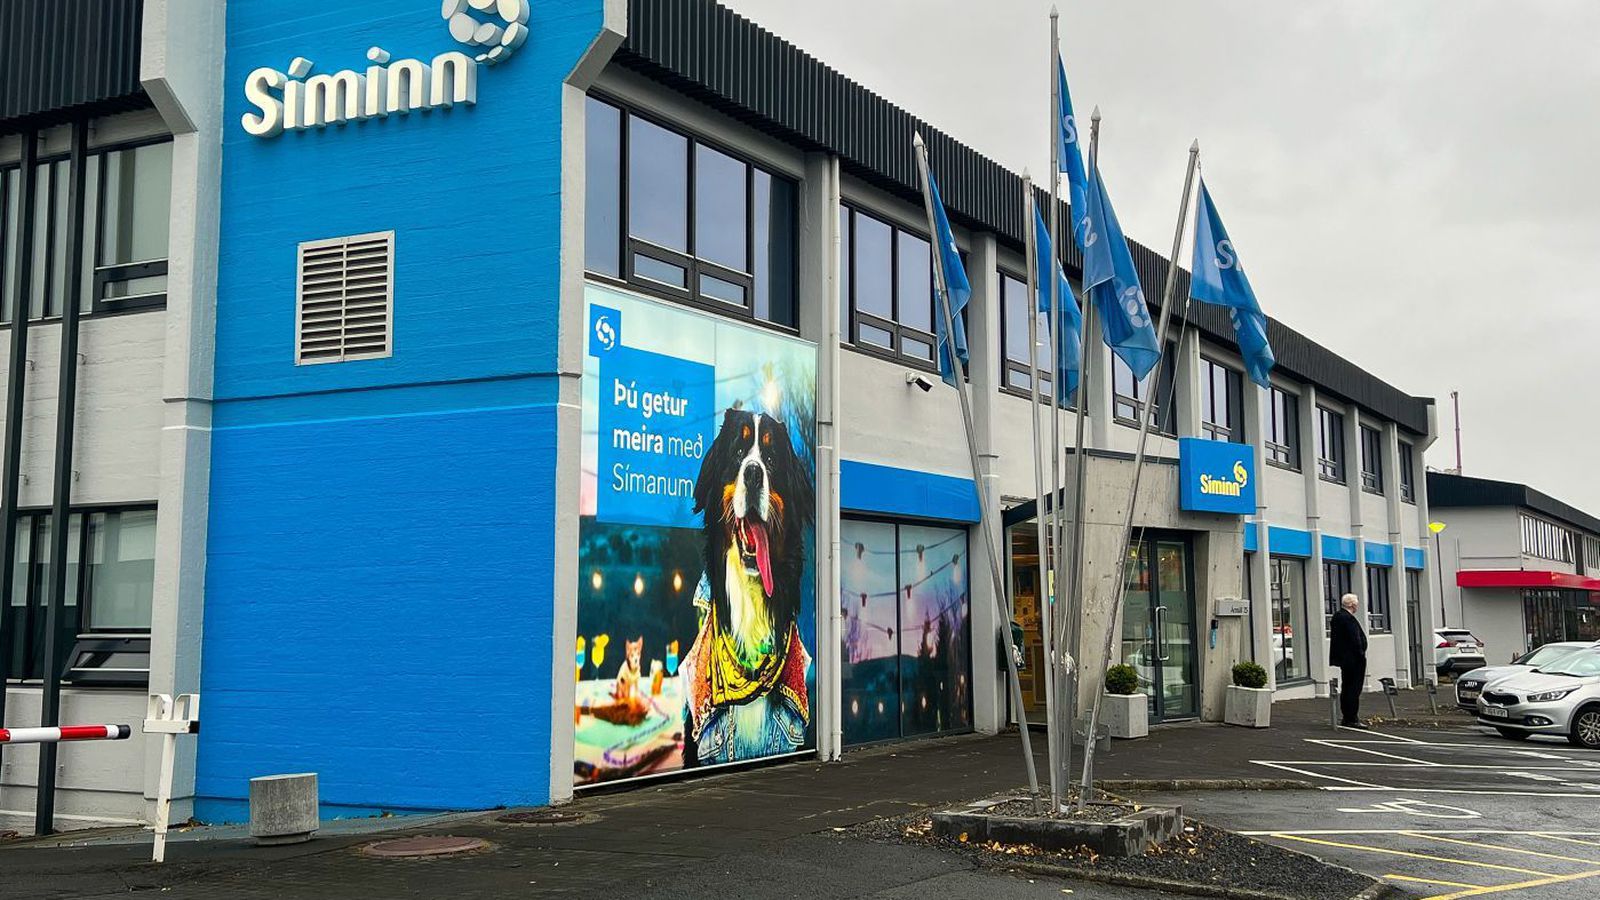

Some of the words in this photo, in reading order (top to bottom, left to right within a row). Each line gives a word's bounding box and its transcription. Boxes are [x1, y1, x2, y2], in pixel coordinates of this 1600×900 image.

[241, 47, 476, 138] Síminn
[613, 378, 638, 408] Þú
[642, 392, 688, 418] getur
[613, 425, 664, 454] meira
[668, 434, 703, 460] með
[612, 463, 694, 498] Símanum
[1200, 474, 1240, 496] Síminn
